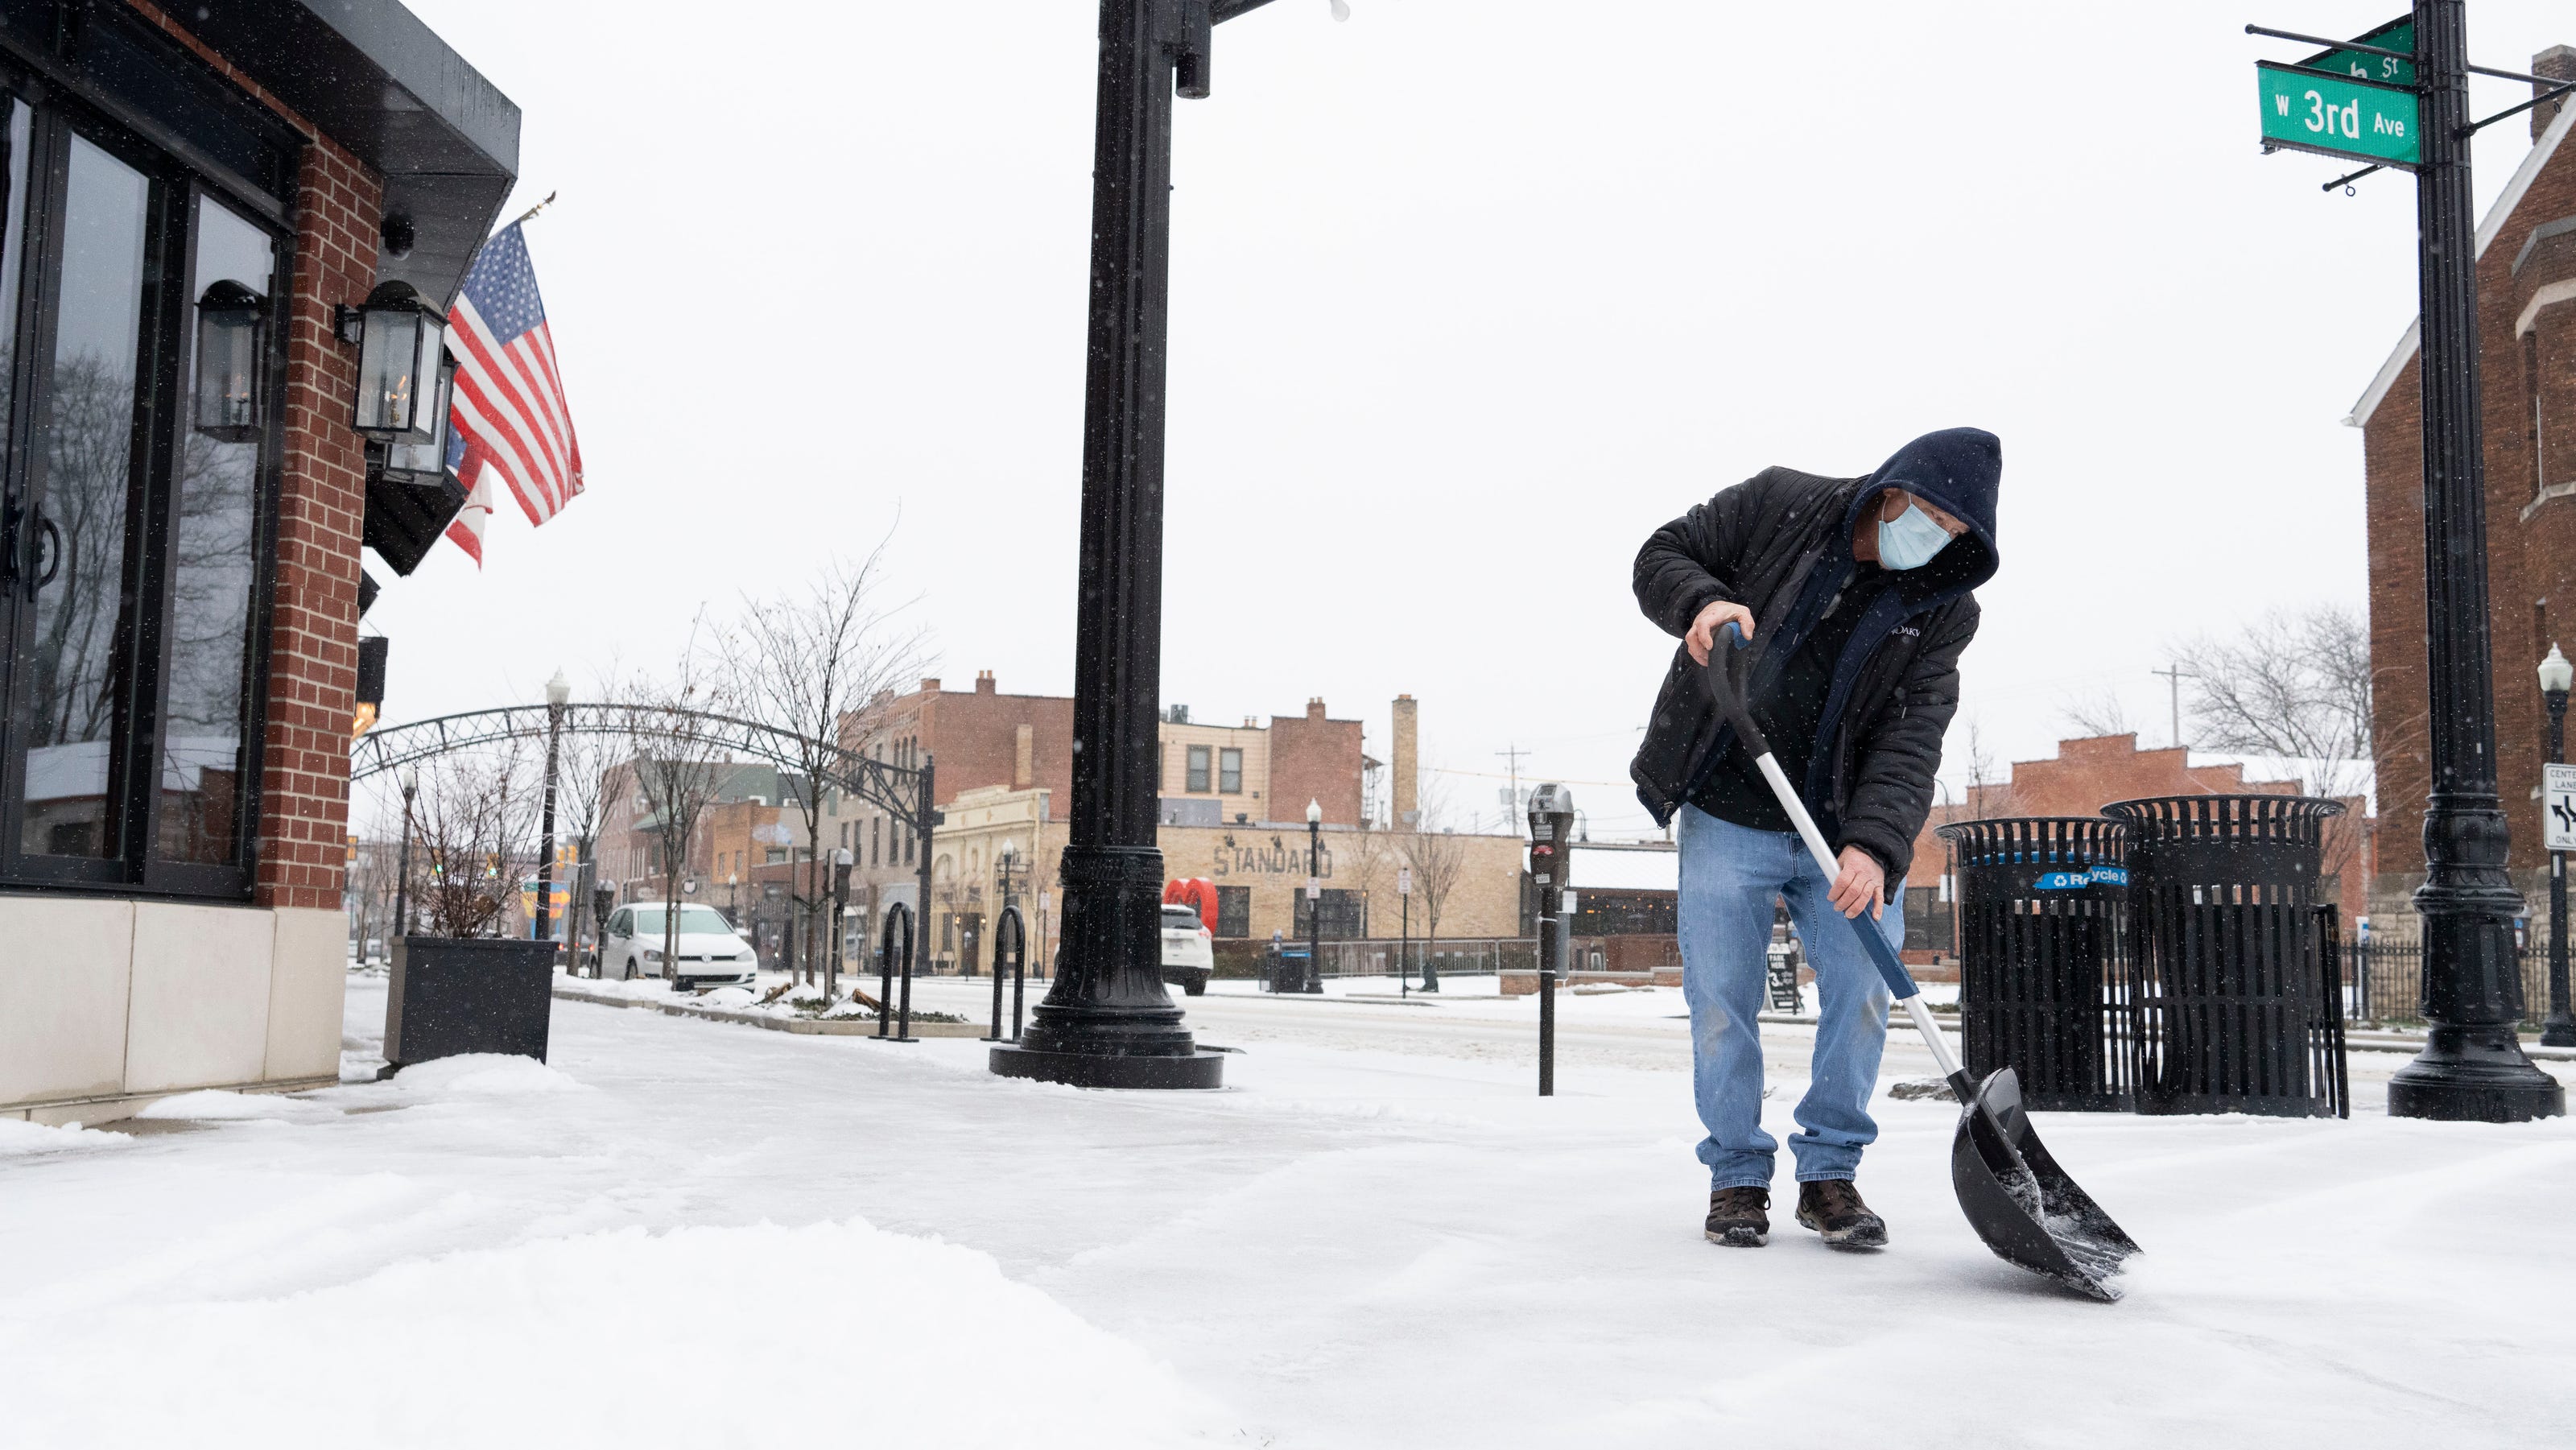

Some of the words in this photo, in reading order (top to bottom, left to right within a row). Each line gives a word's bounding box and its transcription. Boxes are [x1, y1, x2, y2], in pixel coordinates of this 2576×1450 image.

[2382, 56, 2399, 78] St
[2275, 93, 2289, 117] W
[2304, 90, 2359, 139] 3rd
[2374, 112, 2405, 138] Ave
[1213, 845, 1332, 879] STANDARD
